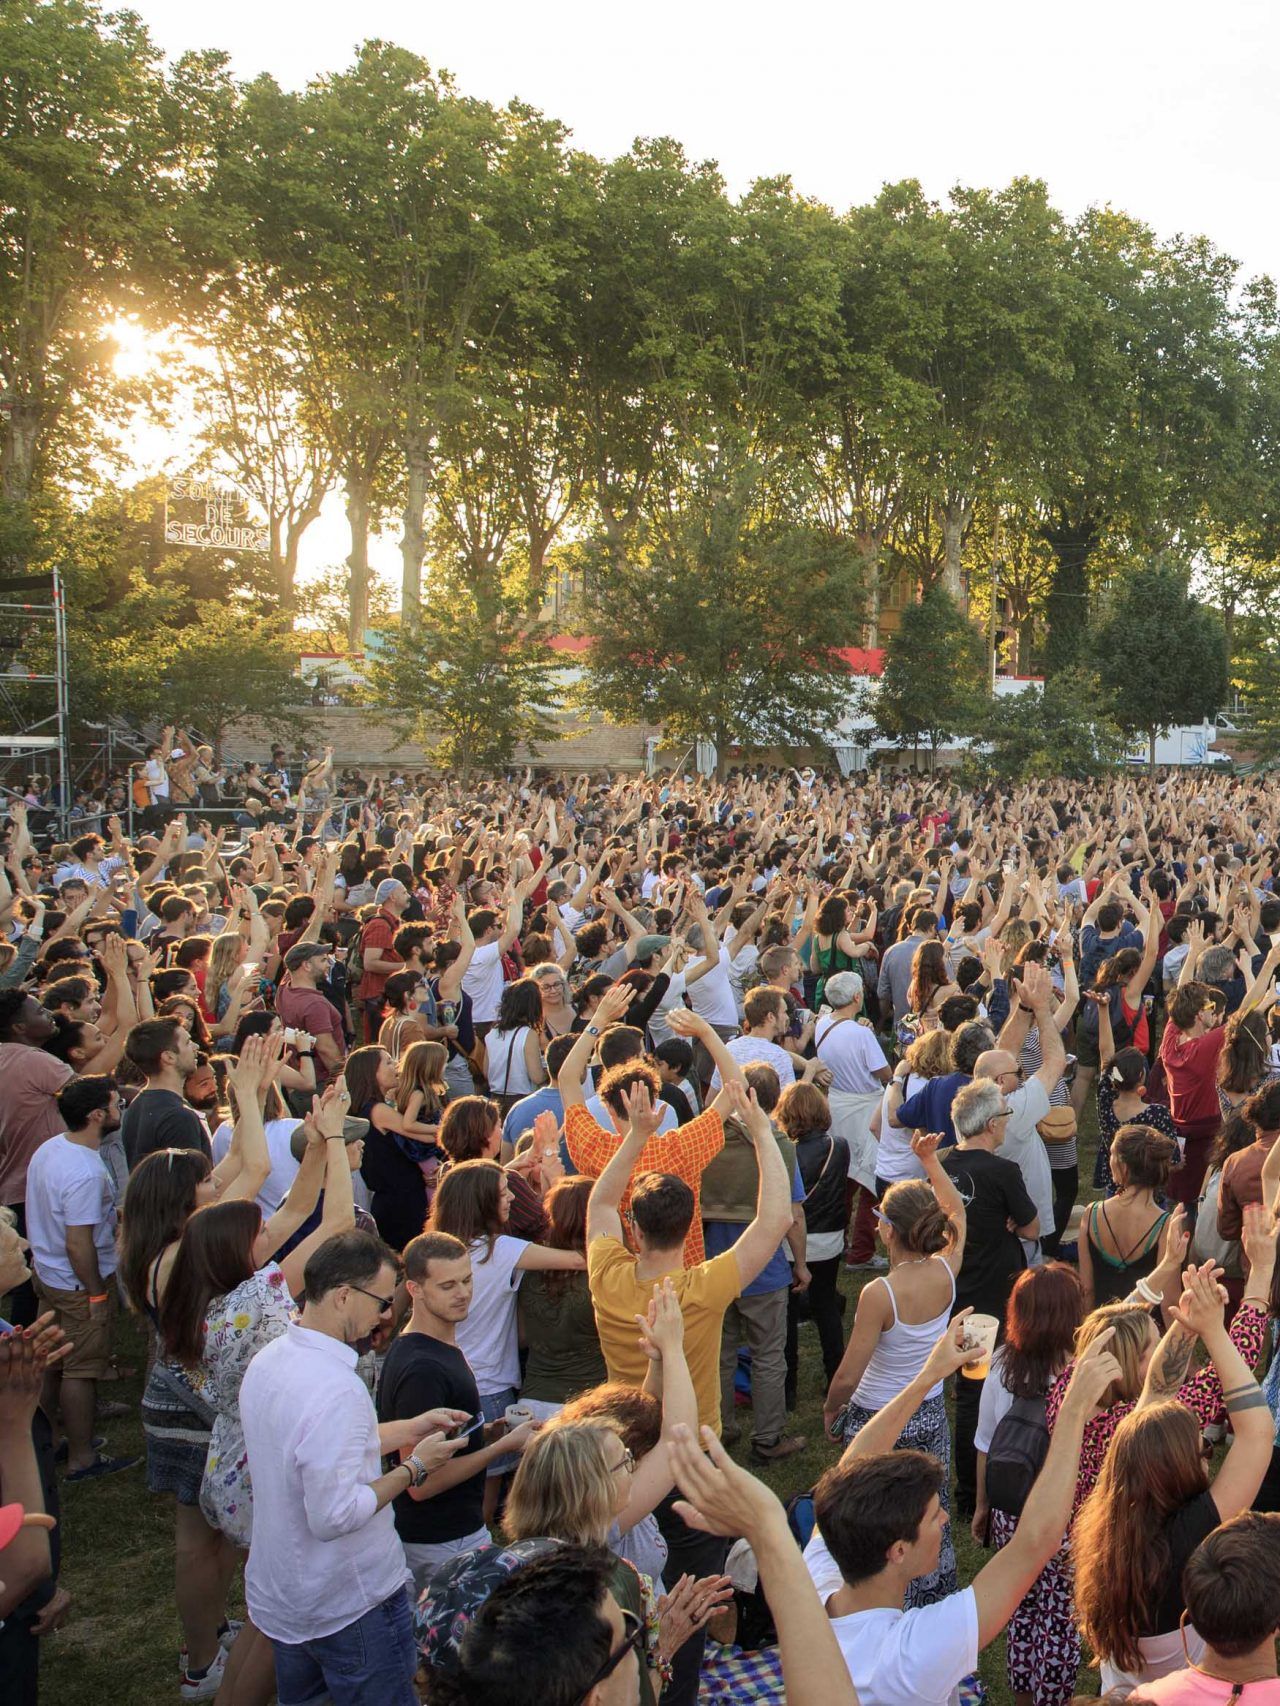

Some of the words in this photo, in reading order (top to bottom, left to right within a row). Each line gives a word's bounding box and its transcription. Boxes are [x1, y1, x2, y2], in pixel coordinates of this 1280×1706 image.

[171, 480, 260, 501] SORTI
[206, 504, 234, 524] DE
[167, 521, 270, 549] SECOURS
